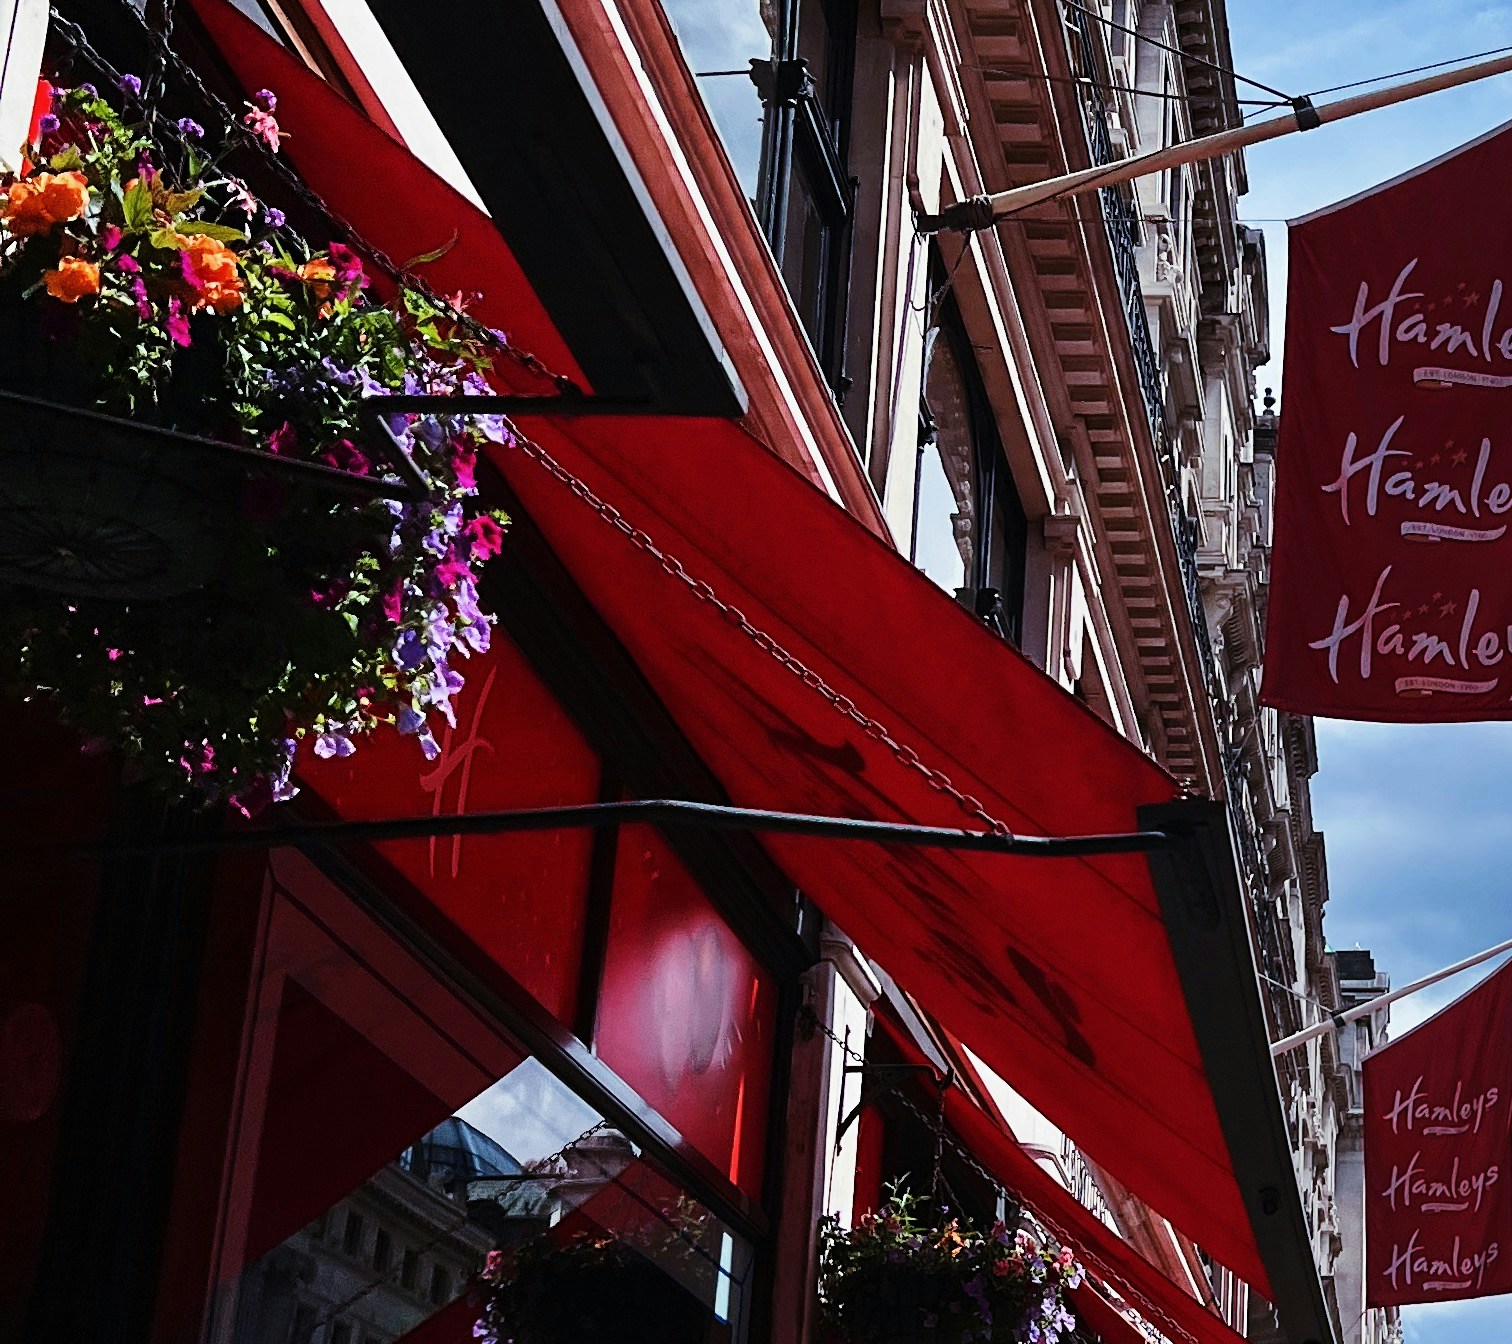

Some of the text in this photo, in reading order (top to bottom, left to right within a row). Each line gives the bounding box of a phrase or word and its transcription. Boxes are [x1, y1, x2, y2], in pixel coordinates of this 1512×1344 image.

[1383, 1076, 1498, 1134] Hamleys
[1382, 1151, 1498, 1212] Hamleys
[1383, 1229, 1498, 1289] Hamleys
